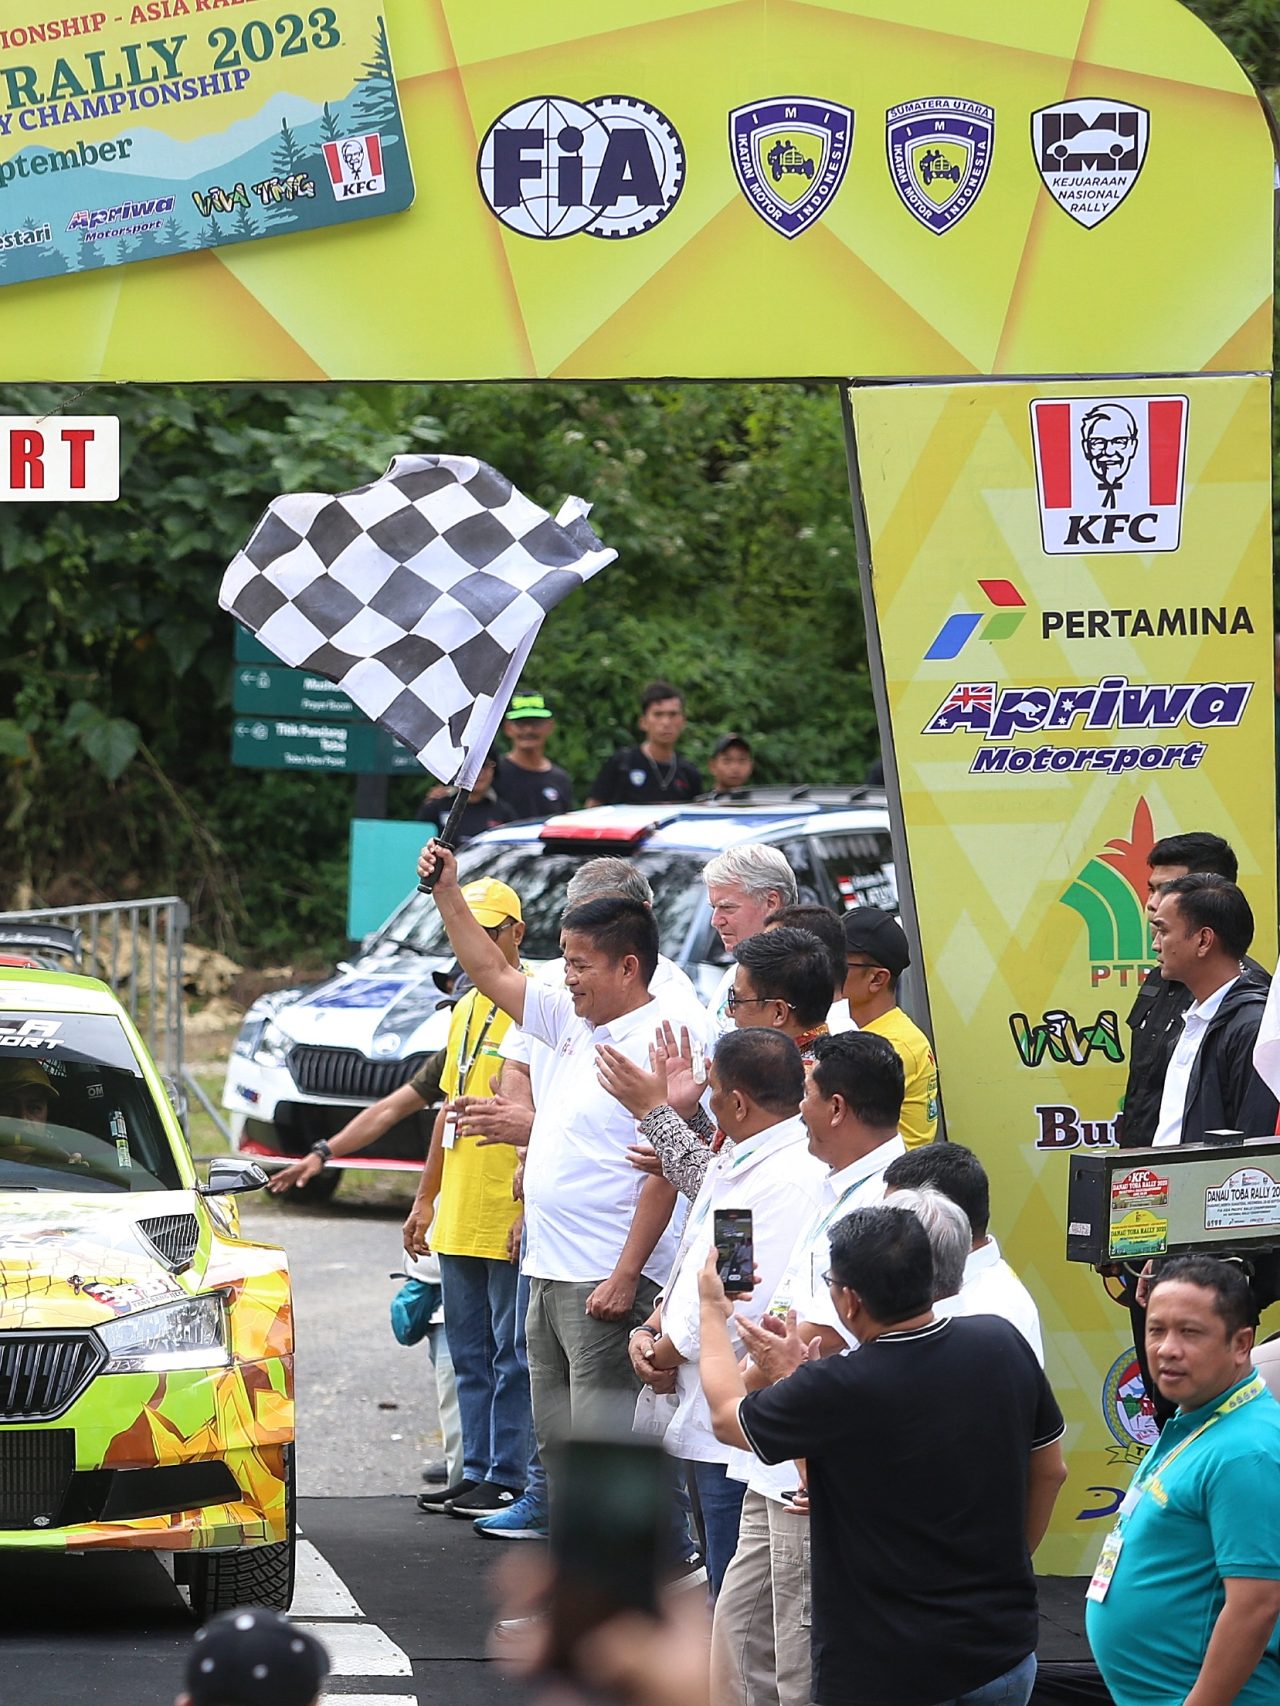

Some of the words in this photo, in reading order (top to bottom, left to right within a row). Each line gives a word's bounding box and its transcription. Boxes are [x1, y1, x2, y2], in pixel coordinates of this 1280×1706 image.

[129, 0, 190, 26] ASIA
[0, 34, 189, 111] RALLY
[207, 7, 342, 71] 2023
[18, 67, 251, 132] CHAMPIONSHIP
[890, 100, 950, 118] SUMATERA
[953, 100, 989, 118] UTARA
[1042, 112, 1139, 172] IMI
[252, 173, 316, 205] TMG
[341, 178, 379, 198] KFC
[738, 133, 755, 179] IKATAN
[749, 182, 783, 221] MOTOR
[796, 130, 845, 222] INDONESIA
[893, 144, 909, 184] IKATAN
[904, 186, 933, 220] MOTOR
[944, 140, 987, 220] INDONESIA
[1052, 176, 1128, 187] KEJUARAAN
[1057, 189, 1121, 200] NASIONAL
[1069, 202, 1110, 213] RALLY
[66, 196, 177, 232] Apriwa
[83, 219, 163, 243] Motorsport
[1063, 513, 1159, 546] KFC
[1041, 606, 1255, 640] PERTAMINA
[921, 675, 1255, 741] Apriwa
[968, 742, 1208, 775] Motorsport
[1131, 1171, 1150, 1183] KFC
[1207, 1189, 1230, 1202] DANAU
[1230, 1188, 1249, 1201] TOBA
[1250, 1186, 1271, 1200] RALLY
